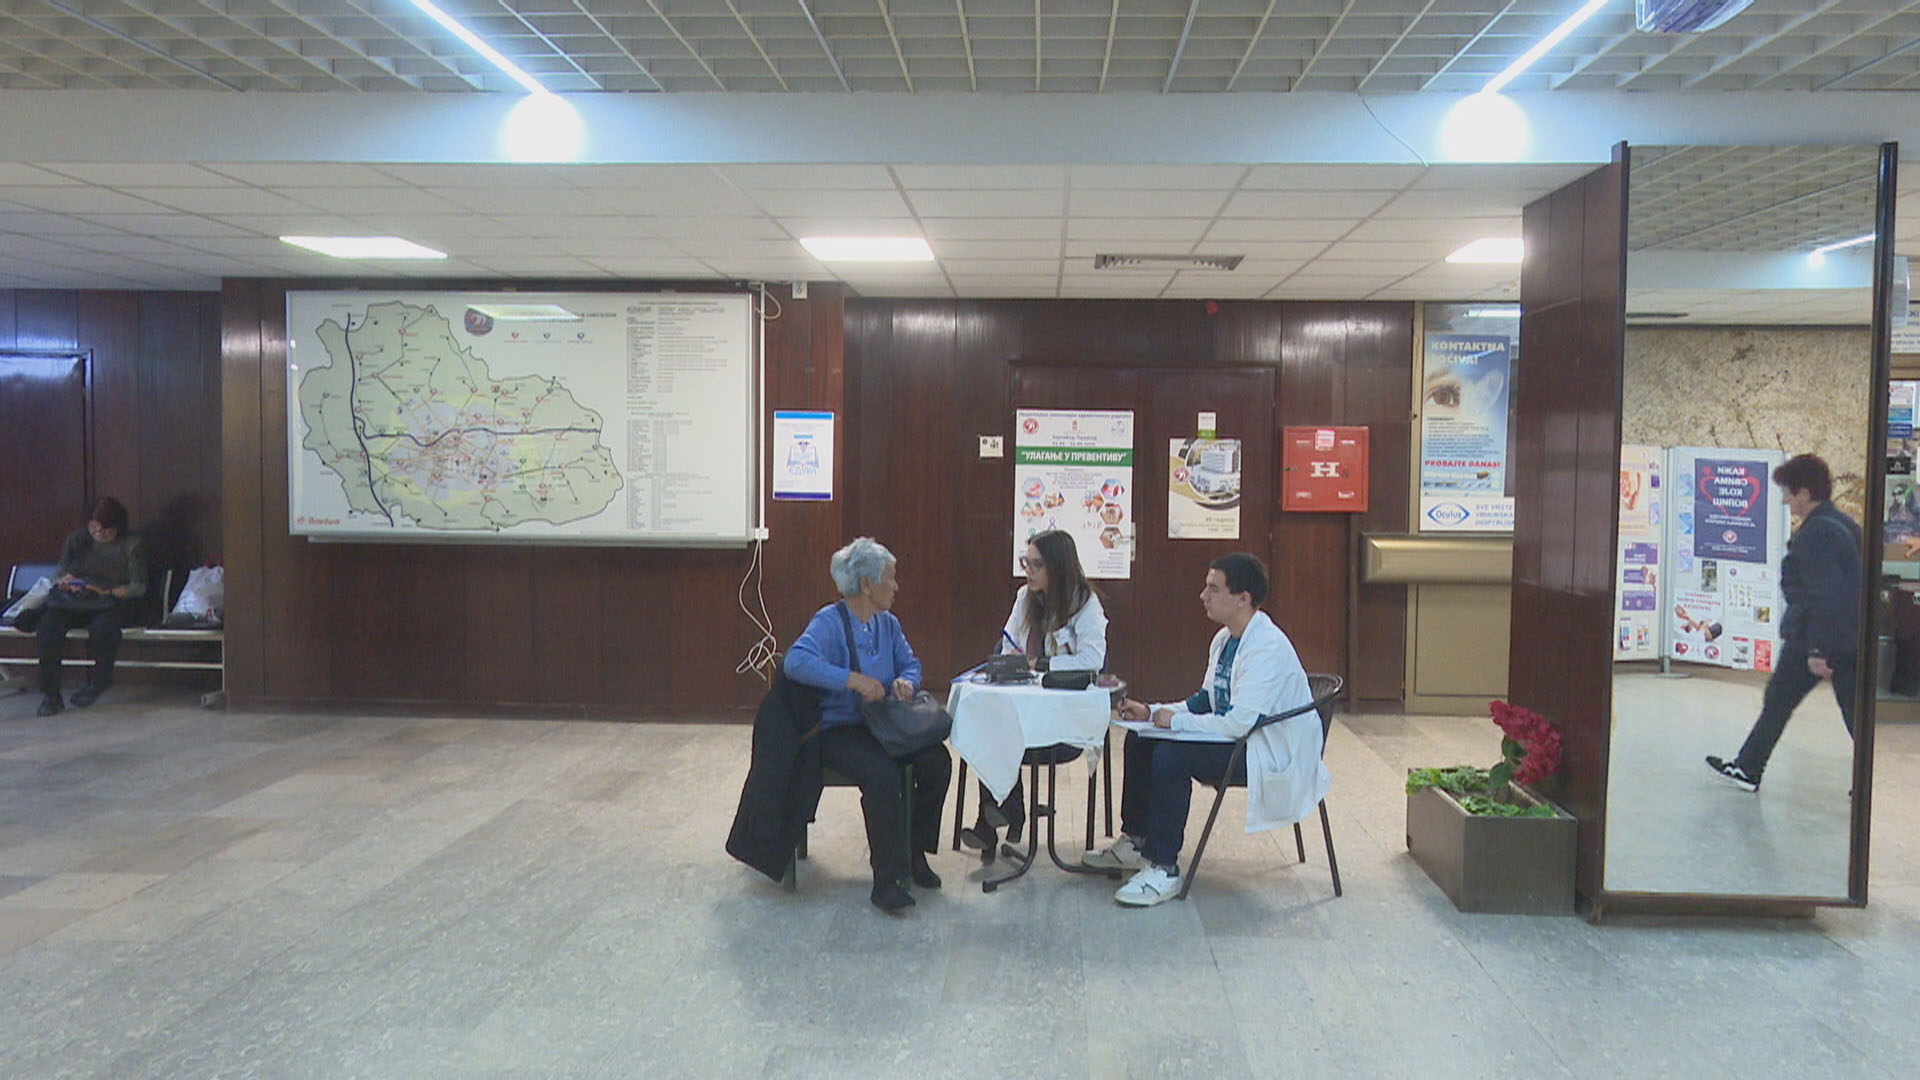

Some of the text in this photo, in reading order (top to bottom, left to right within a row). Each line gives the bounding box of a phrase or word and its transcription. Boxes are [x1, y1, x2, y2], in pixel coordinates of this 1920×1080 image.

[1431, 341, 1505, 352] KONTAKTNA
[1064, 452, 1071, 462] У
[1424, 459, 1501, 469] PROBAJTE DANAS!
[1310, 461, 1340, 478] H
[1435, 509, 1462, 519] Oculus
